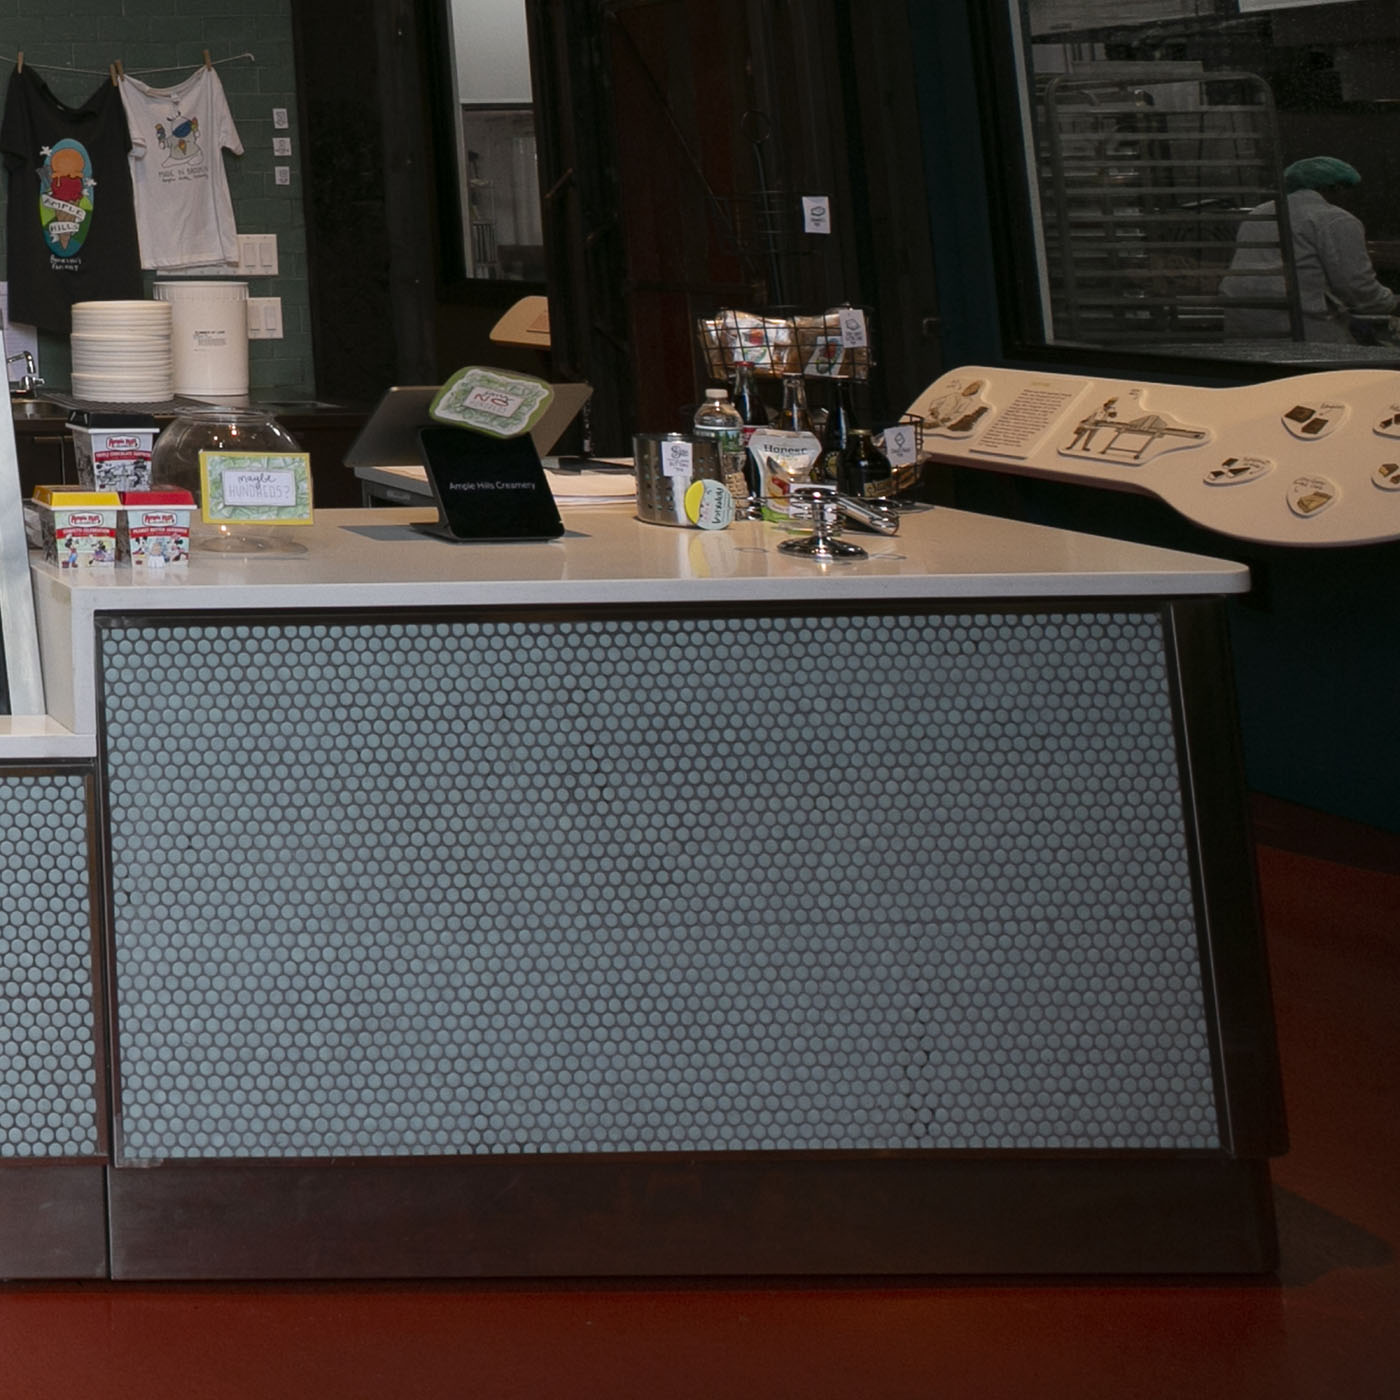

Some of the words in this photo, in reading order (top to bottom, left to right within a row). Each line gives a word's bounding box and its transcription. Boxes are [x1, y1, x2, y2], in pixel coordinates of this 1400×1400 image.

[50, 222, 78, 232] HILLS
[238, 474, 276, 489] maybe
[449, 481, 476, 491] Ample
[477, 481, 495, 490] Hills
[496, 481, 536, 490] Creamery
[229, 484, 290, 499] HUNDREDS?
